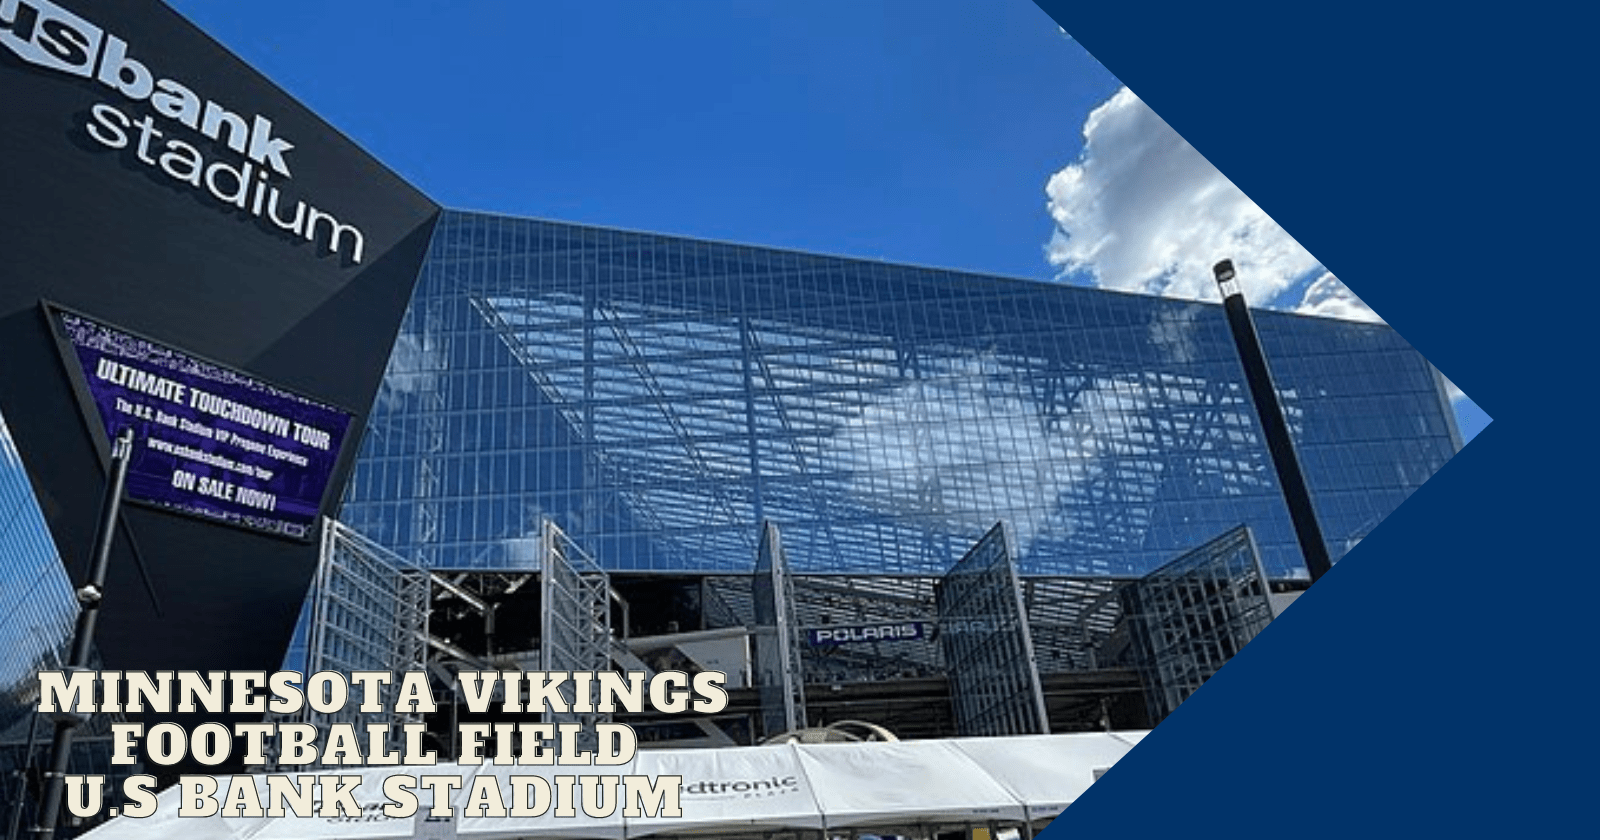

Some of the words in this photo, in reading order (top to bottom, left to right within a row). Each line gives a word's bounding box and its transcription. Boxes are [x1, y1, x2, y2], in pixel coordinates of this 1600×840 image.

[86, 103, 364, 264] stadium
[96, 357, 186, 405] ULTIMATE
[189, 387, 291, 438] TOUCHDOWN
[293, 421, 331, 450] TOUR
[115, 397, 133, 415] The
[172, 469, 196, 492] ON
[197, 476, 235, 502] SALE
[235, 486, 276, 512] NOW!
[815, 624, 918, 643] POLARIS
[680, 776, 798, 795] dtronic
